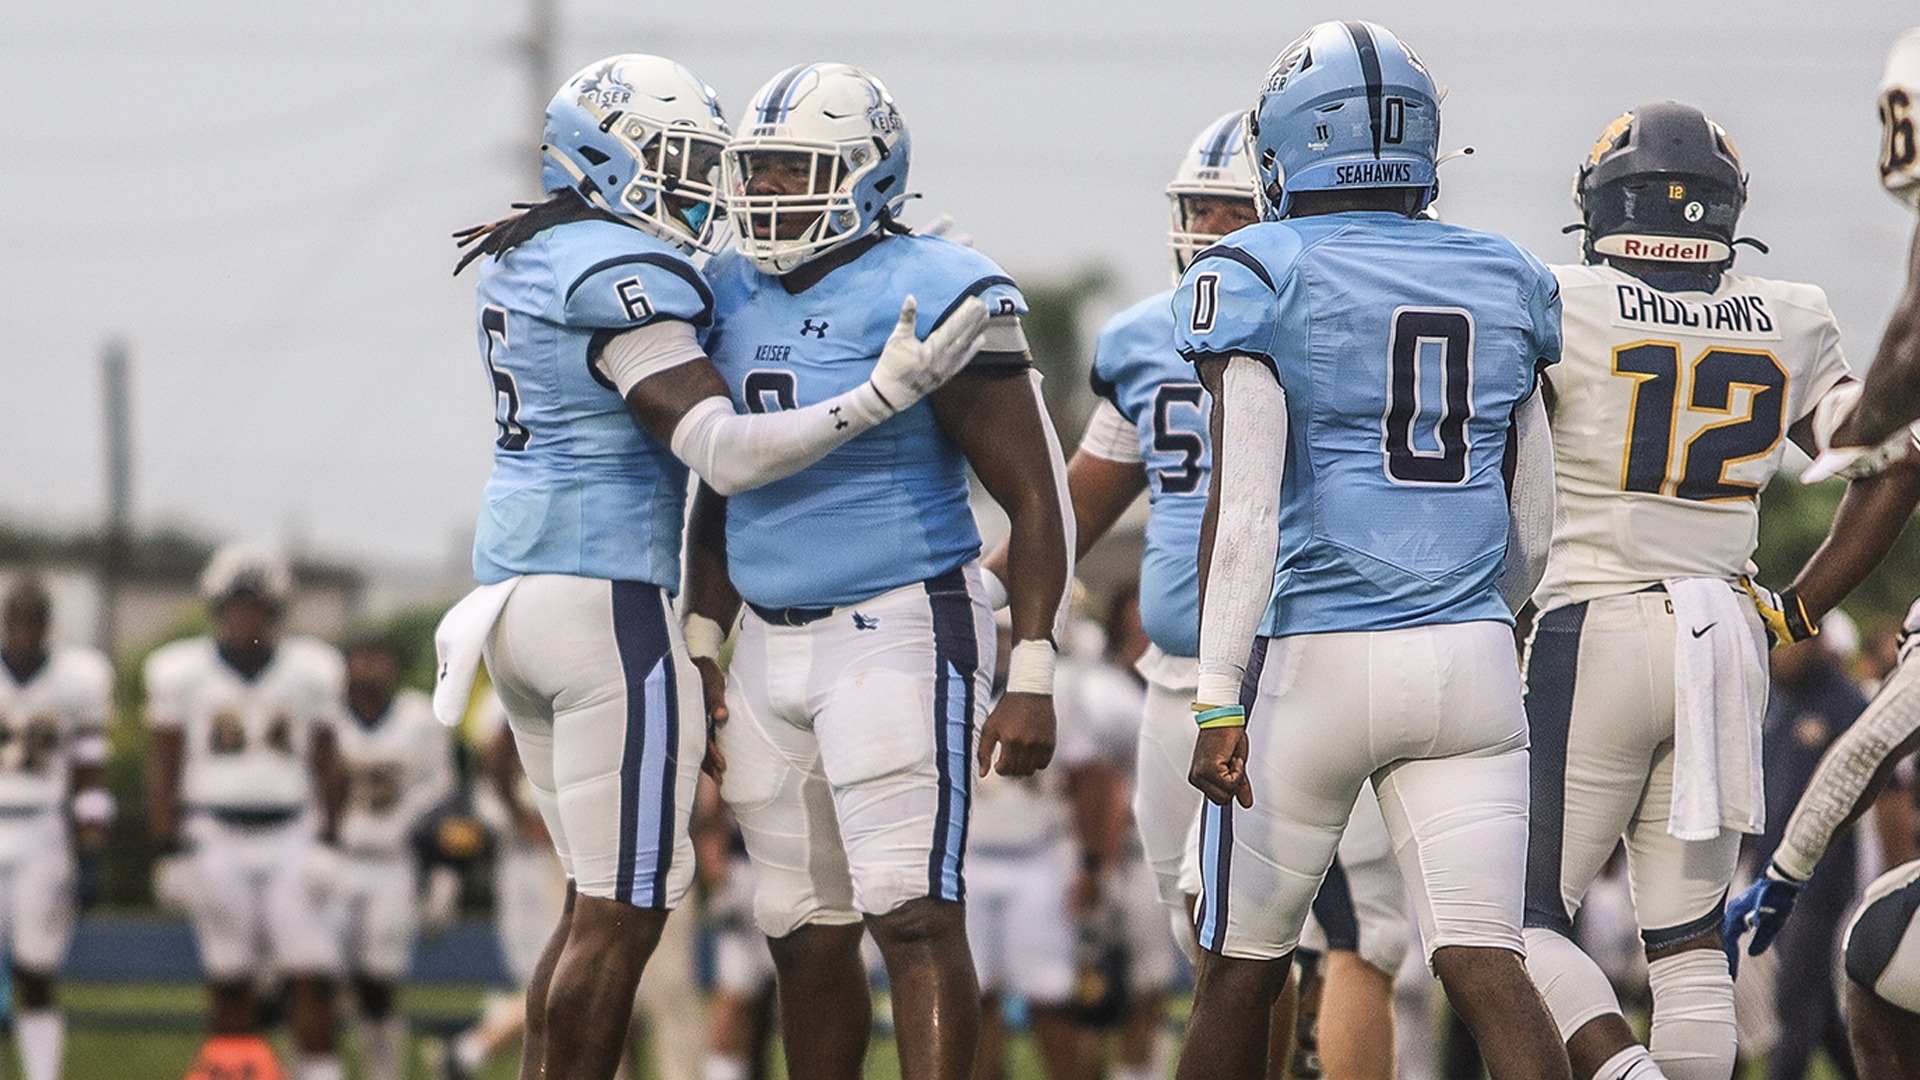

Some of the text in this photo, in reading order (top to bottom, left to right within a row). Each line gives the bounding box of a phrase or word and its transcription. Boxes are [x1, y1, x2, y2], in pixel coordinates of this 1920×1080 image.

[577, 91, 631, 104] EISER
[1385, 97, 1404, 144] 0
[1336, 163, 1411, 185] SEAHAWKS
[1667, 184, 1685, 200] 12
[1625, 239, 1709, 260] Riddell
[613, 274, 656, 322] 6
[1191, 273, 1221, 335] 0
[753, 344, 792, 362] KEISER
[481, 302, 534, 452] 6
[1380, 305, 1477, 486] 0
[1611, 339, 1791, 503] 12
